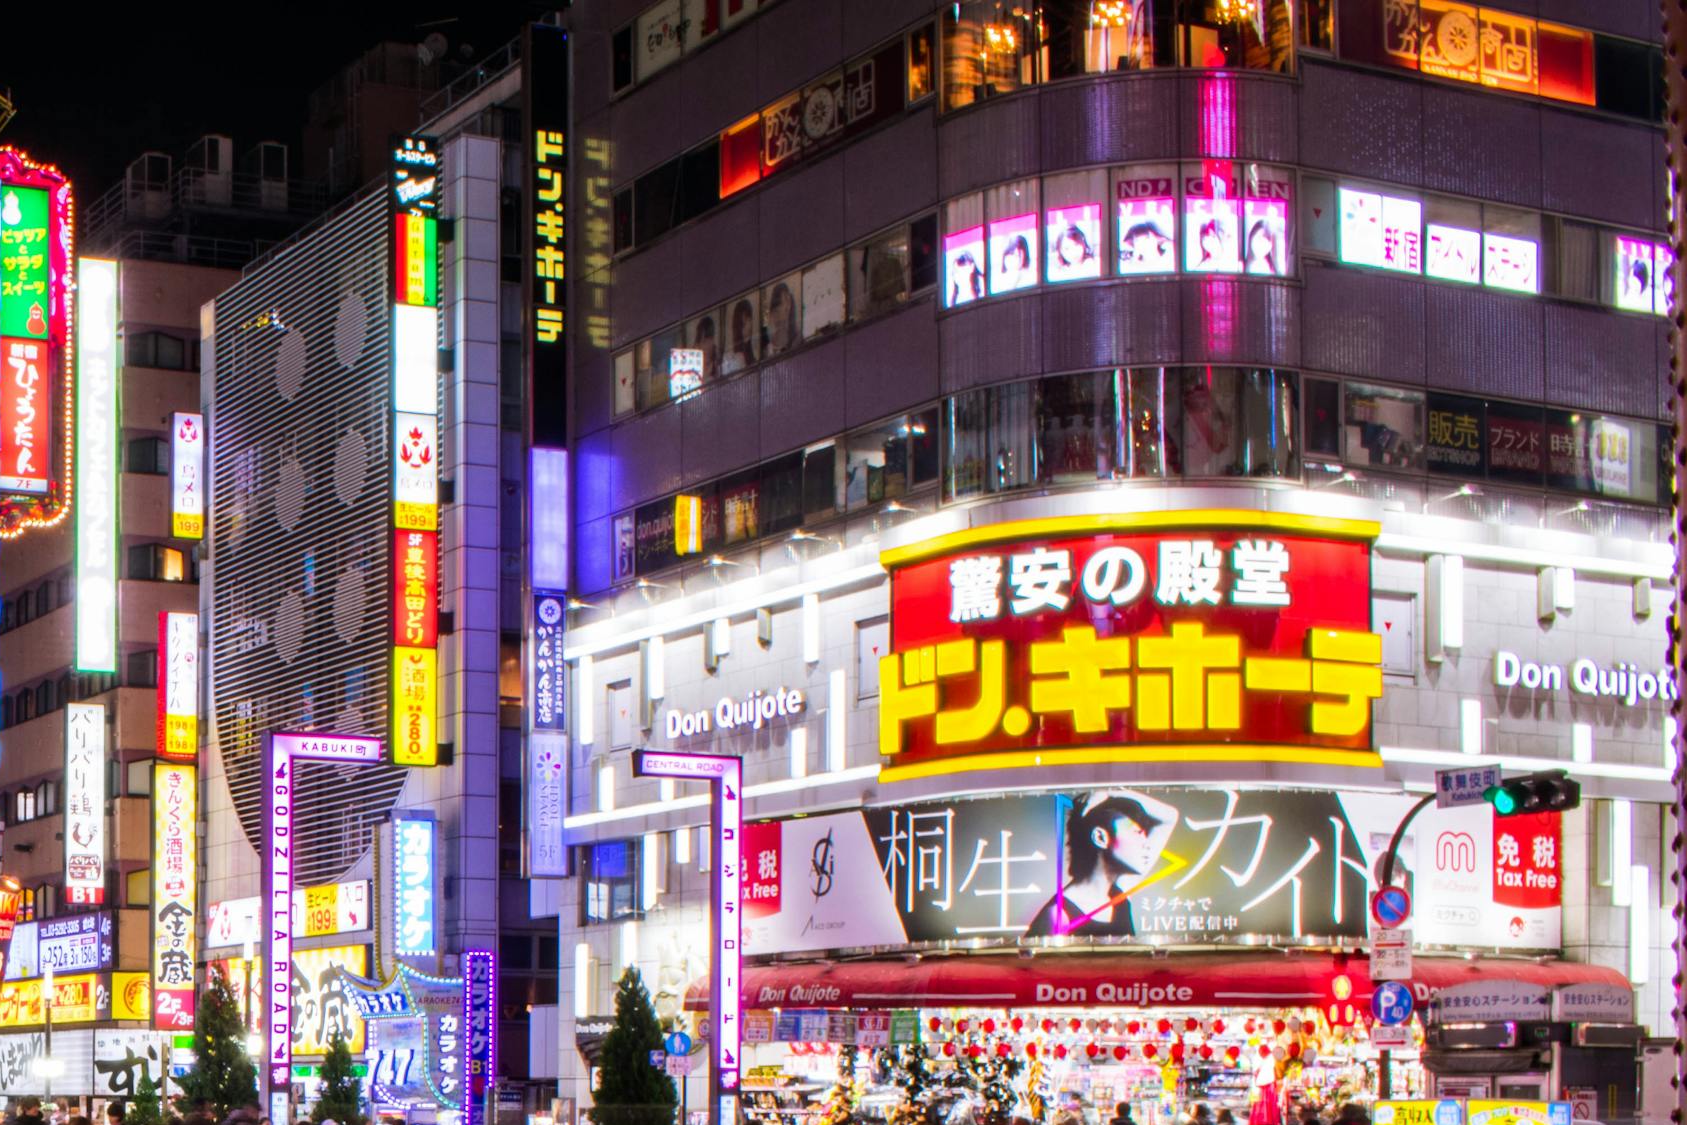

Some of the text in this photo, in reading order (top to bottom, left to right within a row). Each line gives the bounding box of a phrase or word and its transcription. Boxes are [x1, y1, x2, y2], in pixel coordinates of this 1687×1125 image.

[8, 357, 40, 475] ひょうたん
[1429, 410, 1480, 449] 販売
[1490, 426, 1540, 451] ブランド
[949, 539, 1292, 622] 驚安の殿堂
[1496, 651, 1562, 690] Don
[666, 687, 803, 739] Don Quijote
[408, 713, 421, 754] 280
[300, 741, 367, 757] KABUKI町
[646, 759, 724, 773] CENTRAL ROAD
[1441, 770, 1495, 793] 歌舞伎町
[165, 771, 184, 874] きんくら酒場
[880, 787, 1369, 938] 桐生 カイト
[1496, 833, 1556, 869] 免税
[402, 826, 433, 948] カラオケ
[753, 881, 779, 899] Free
[1496, 868, 1557, 889] Tax Free
[72, 887, 96, 903] B1
[1140, 896, 1212, 914] ミクチャで
[273, 784, 288, 1035] GODZILLA ROAD
[1140, 915, 1239, 931] LIVE配信中
[158, 901, 195, 984] 金の蔵
[96, 984, 110, 1010] 2F
[158, 994, 181, 1013] 2F
[356, 994, 407, 1014] カラオケ
[759, 984, 841, 1004] Don Quijote
[1036, 983, 1194, 1006] Don Quijote
[1414, 983, 1443, 1001] Do
[1443, 994, 1544, 1008] 安全安心ステーション
[1563, 993, 1629, 1007] 安全安心ステーション
[471, 957, 489, 1056] カラオケ
[1392, 1008, 1404, 1019] 40
[439, 1014, 460, 1094] カラオケ
[365, 1049, 414, 1087] 747
